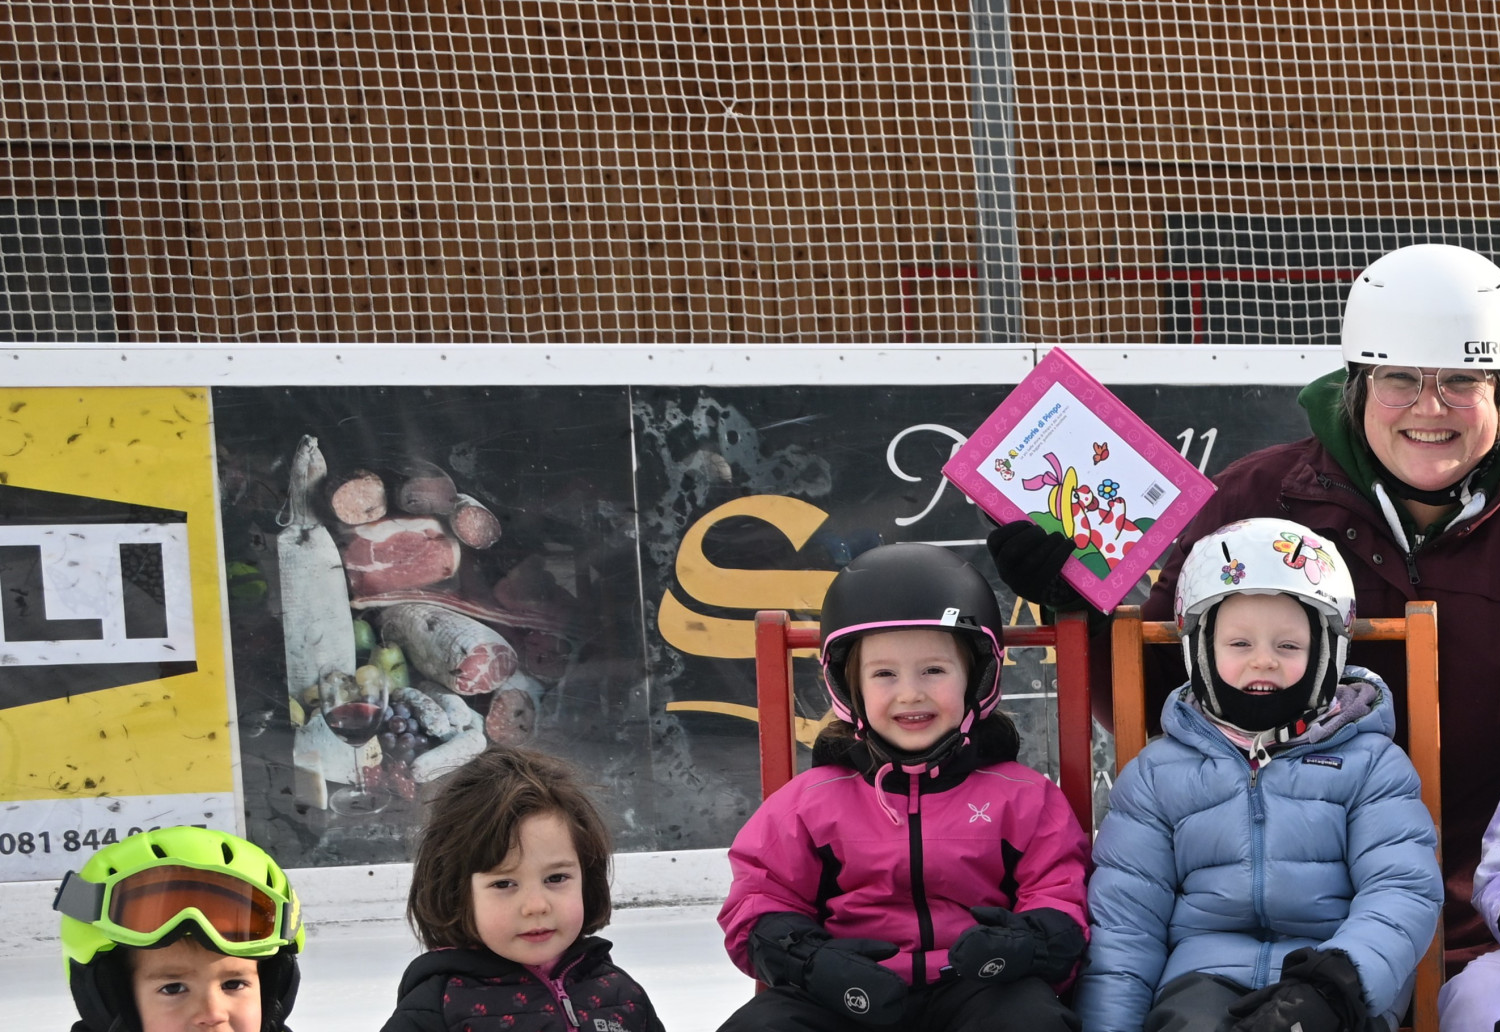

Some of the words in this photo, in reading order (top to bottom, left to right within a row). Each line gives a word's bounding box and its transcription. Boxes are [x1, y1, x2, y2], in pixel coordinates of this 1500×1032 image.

[1042, 403, 1061, 421] Pimpa
[0, 831, 51, 855] 081
[63, 828, 119, 852] 844
